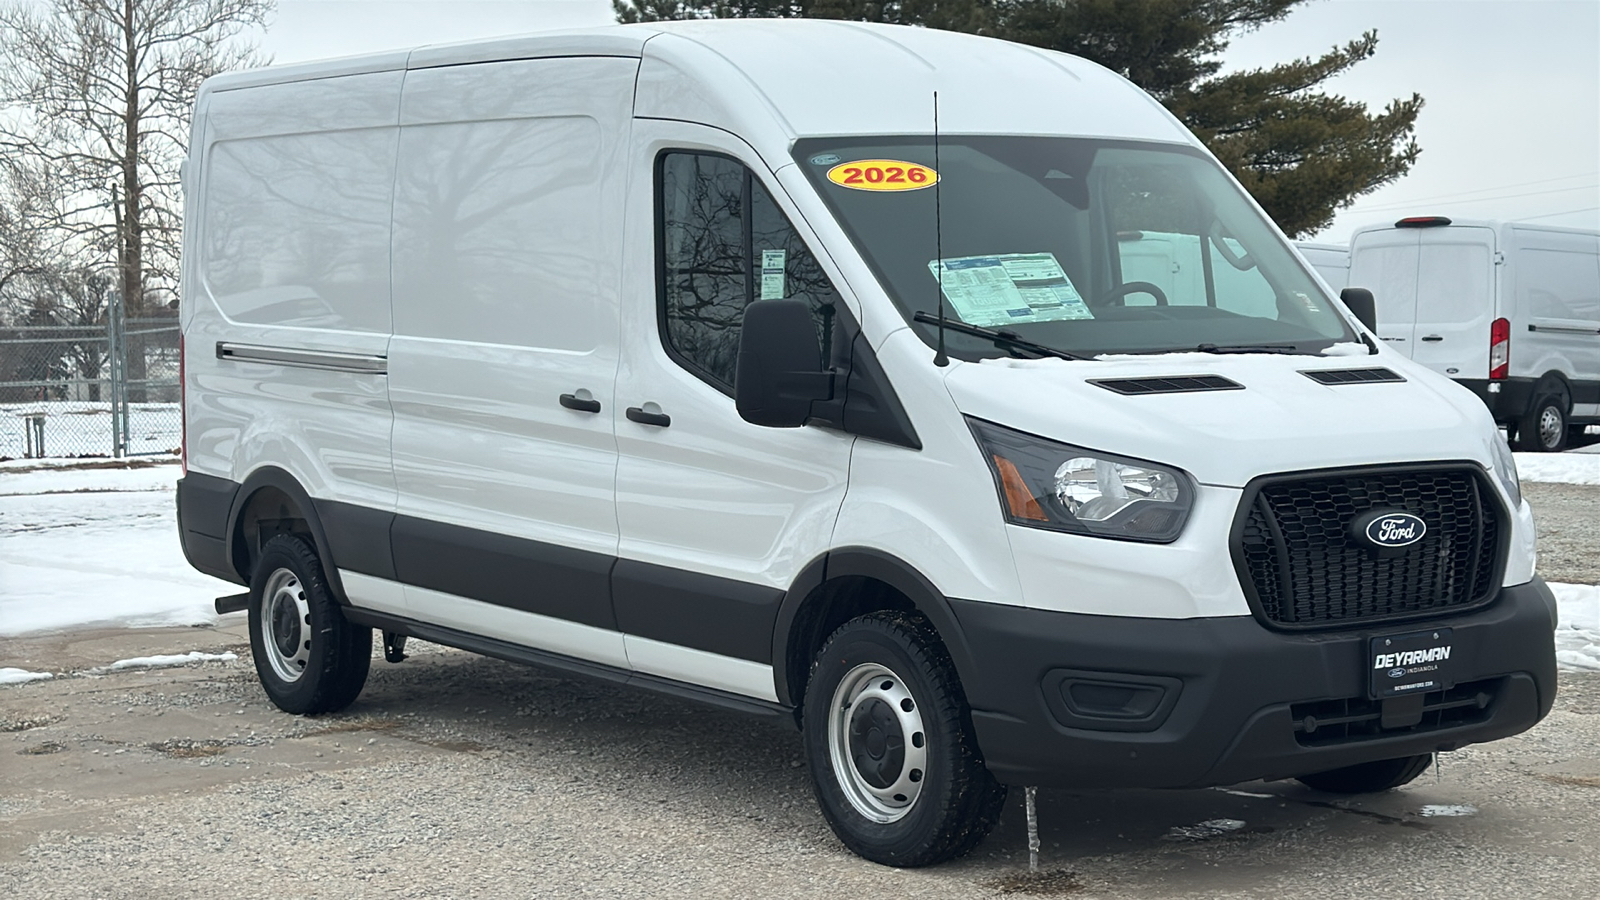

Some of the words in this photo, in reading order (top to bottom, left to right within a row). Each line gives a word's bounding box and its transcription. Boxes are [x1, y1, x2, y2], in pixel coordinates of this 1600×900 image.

[843, 167, 927, 183] 2026
[1379, 519, 1415, 541] Ford
[1374, 646, 1451, 669] DEYARMAN
[1407, 665, 1438, 674] INDIANOLA
